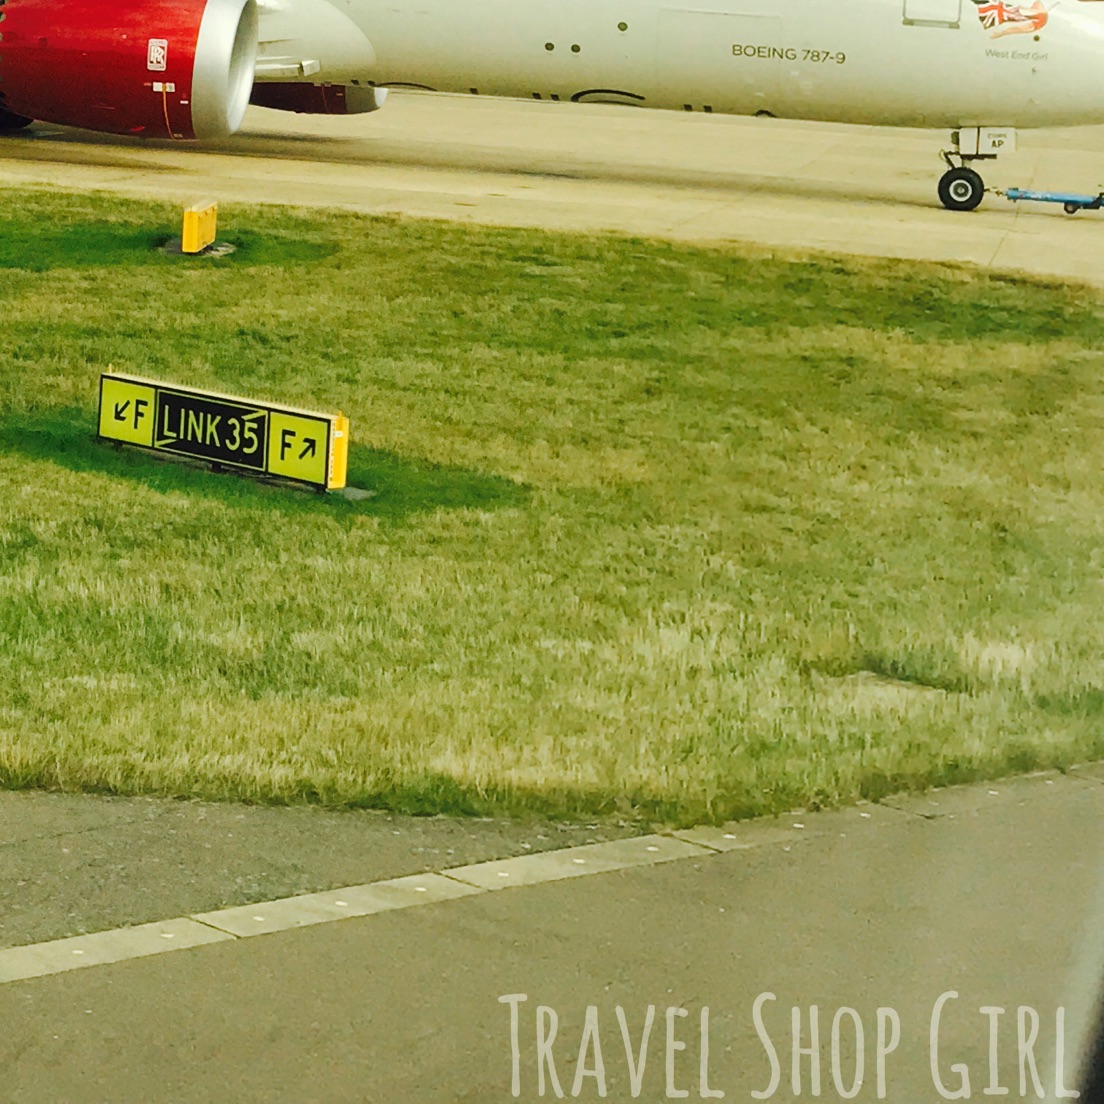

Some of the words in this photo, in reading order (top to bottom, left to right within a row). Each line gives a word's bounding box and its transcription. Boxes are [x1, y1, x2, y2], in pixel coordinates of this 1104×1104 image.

[732, 44, 797, 61] BOEING
[801, 49, 846, 65] 787-9
[985, 49, 1009, 59] West
[1011, 50, 1031, 60] End
[134, 400, 148, 429] F
[280, 429, 295, 460] F
